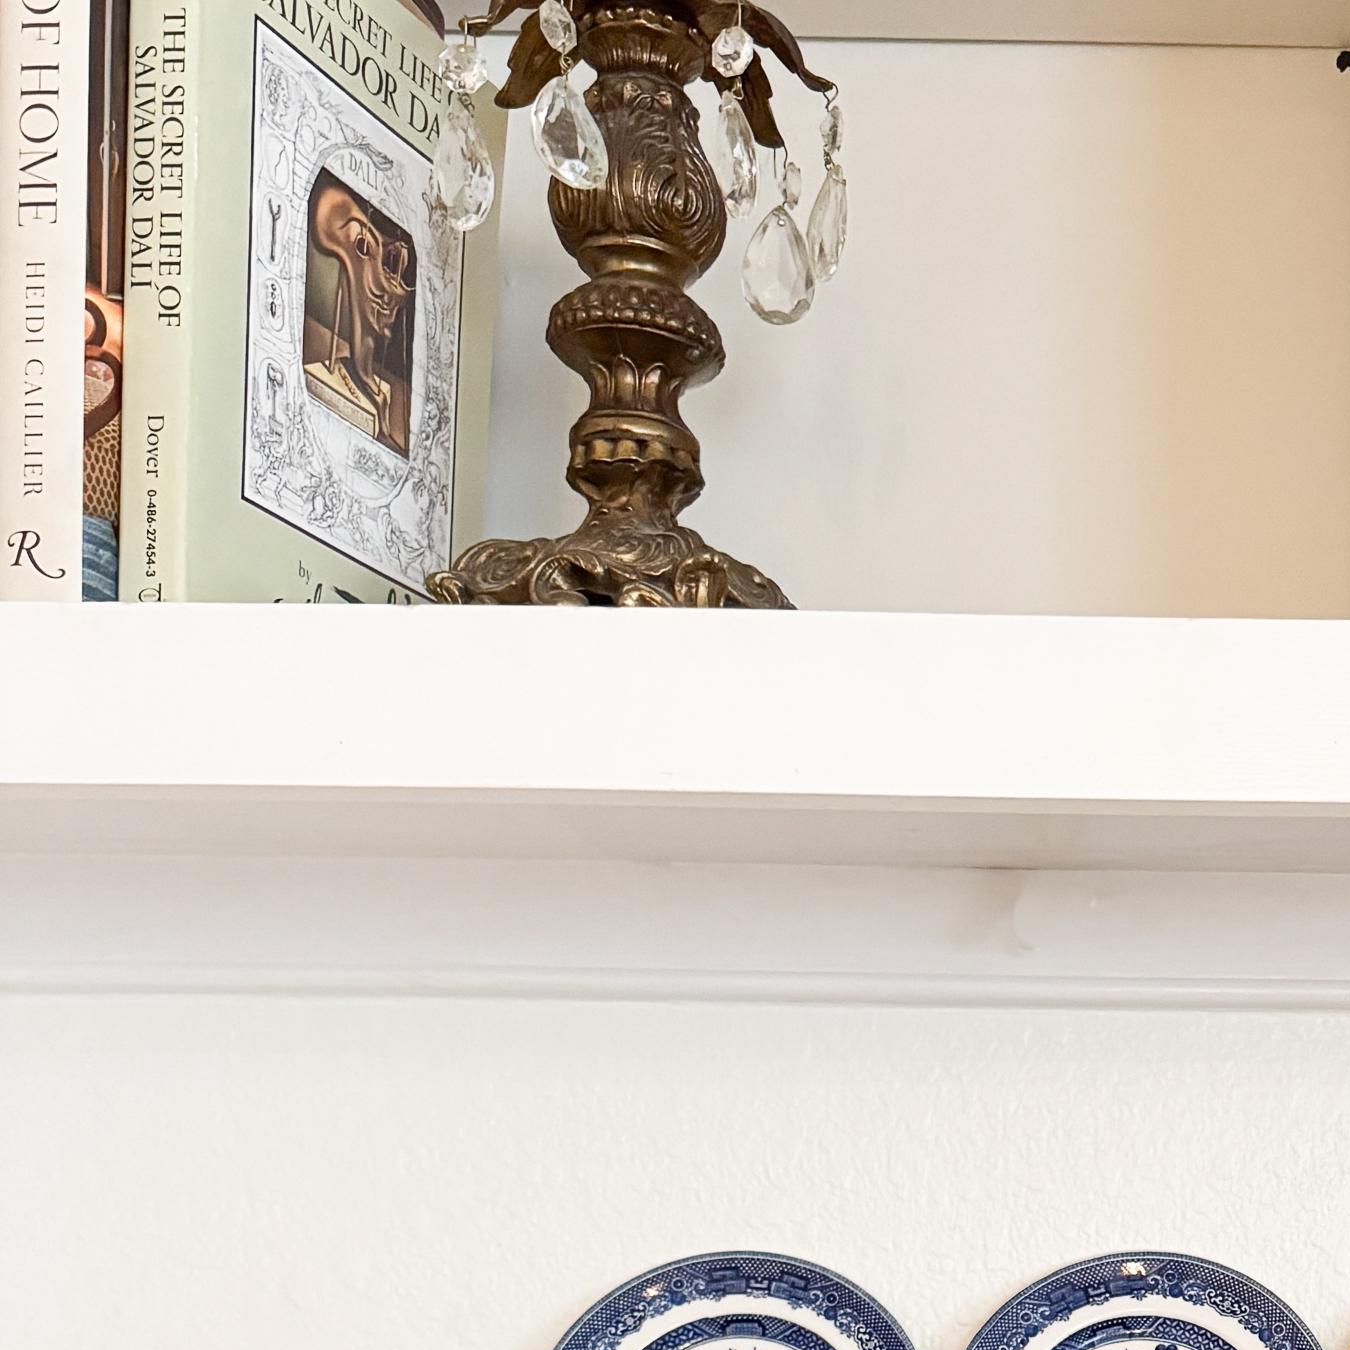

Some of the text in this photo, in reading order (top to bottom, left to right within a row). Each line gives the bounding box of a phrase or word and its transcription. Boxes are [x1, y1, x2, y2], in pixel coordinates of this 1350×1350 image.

[18, 62, 60, 227] HOME
[400, 43, 443, 104] LIFE
[130, 45, 160, 289] SALVADOR DALÍ
[157, 8, 186, 326] THE SECRET LIFE OF
[24, 263, 45, 495] HEIDI CAILLIER
[147, 416, 164, 478] Dover
[299, 560, 309, 584] by
